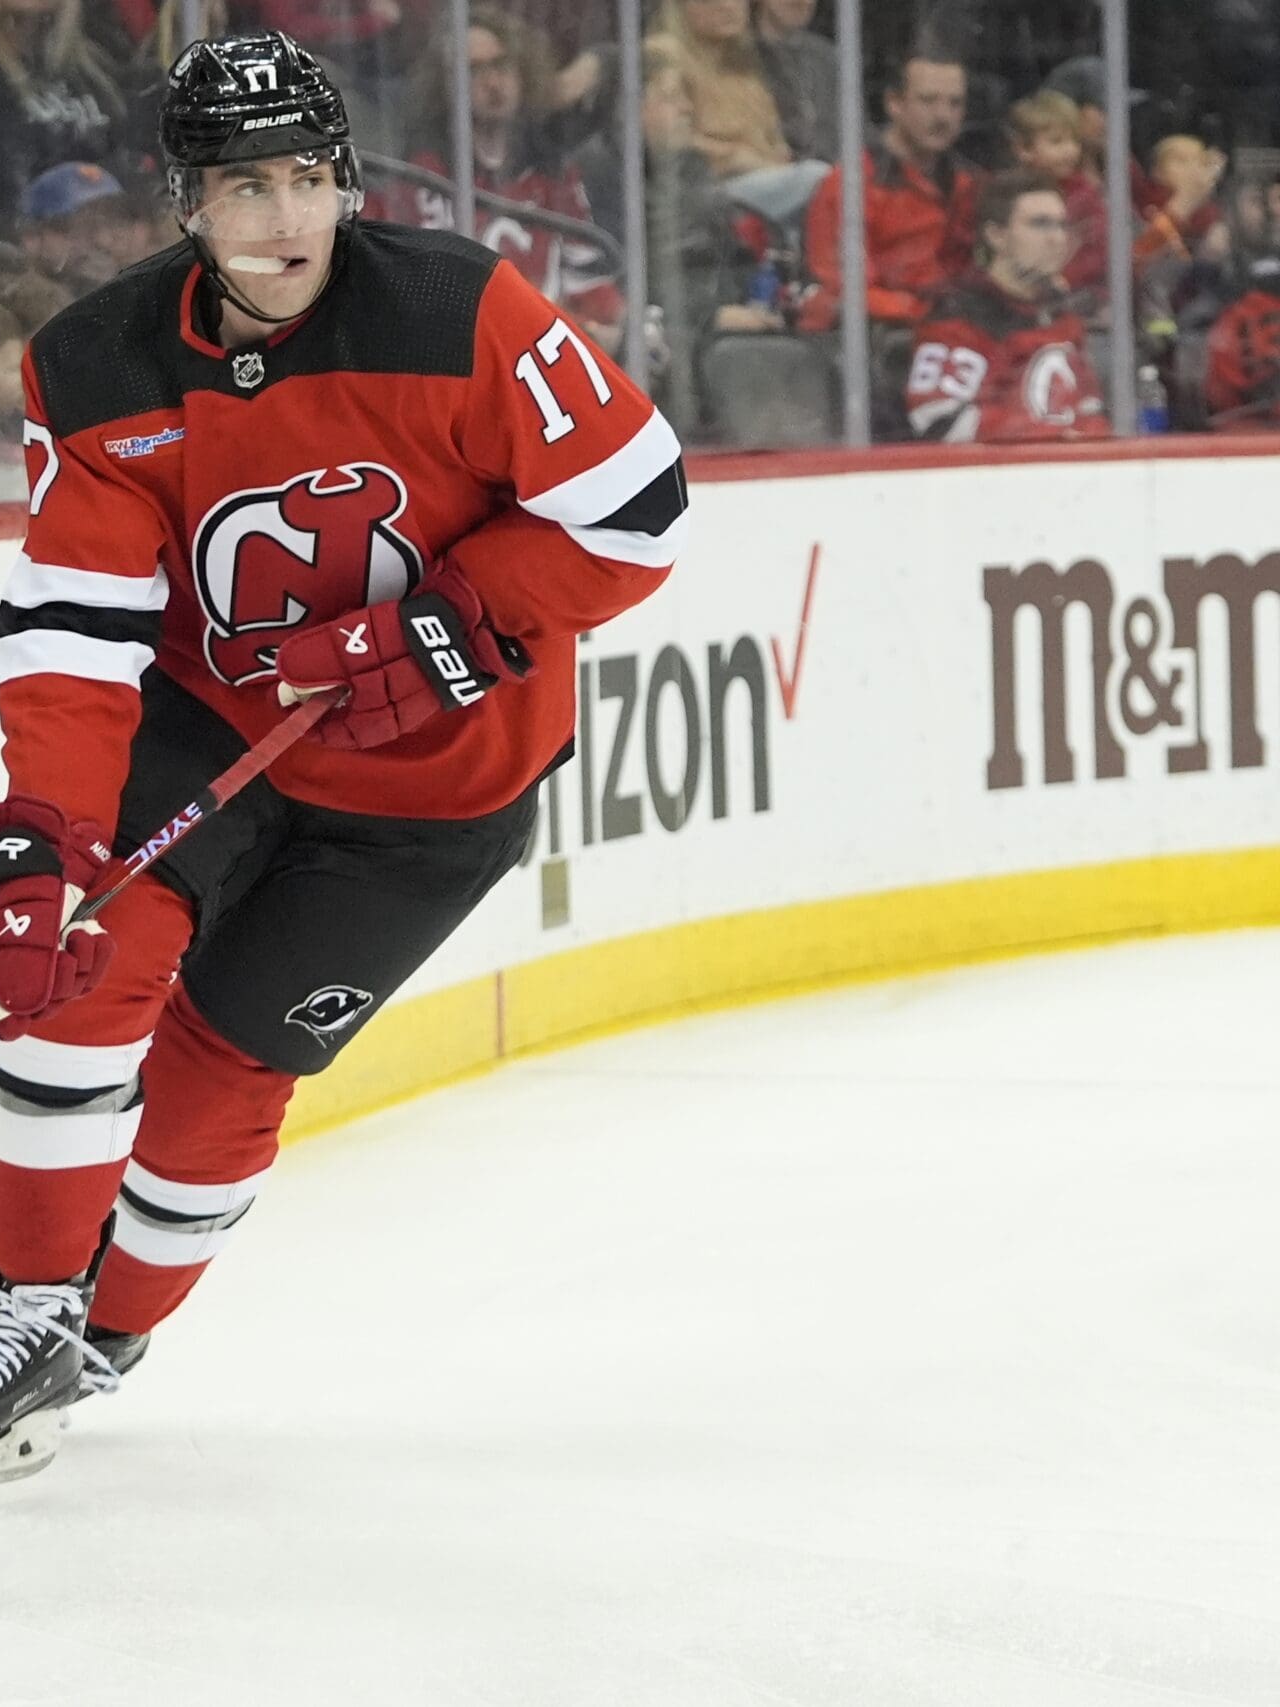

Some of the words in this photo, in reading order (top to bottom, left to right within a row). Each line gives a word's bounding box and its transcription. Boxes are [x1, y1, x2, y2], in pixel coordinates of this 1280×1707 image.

[244, 64, 278, 93] 17
[242, 111, 304, 132] BAUER
[514, 316, 613, 445] 17
[908, 342, 988, 401] 63
[518, 630, 771, 868] izon
